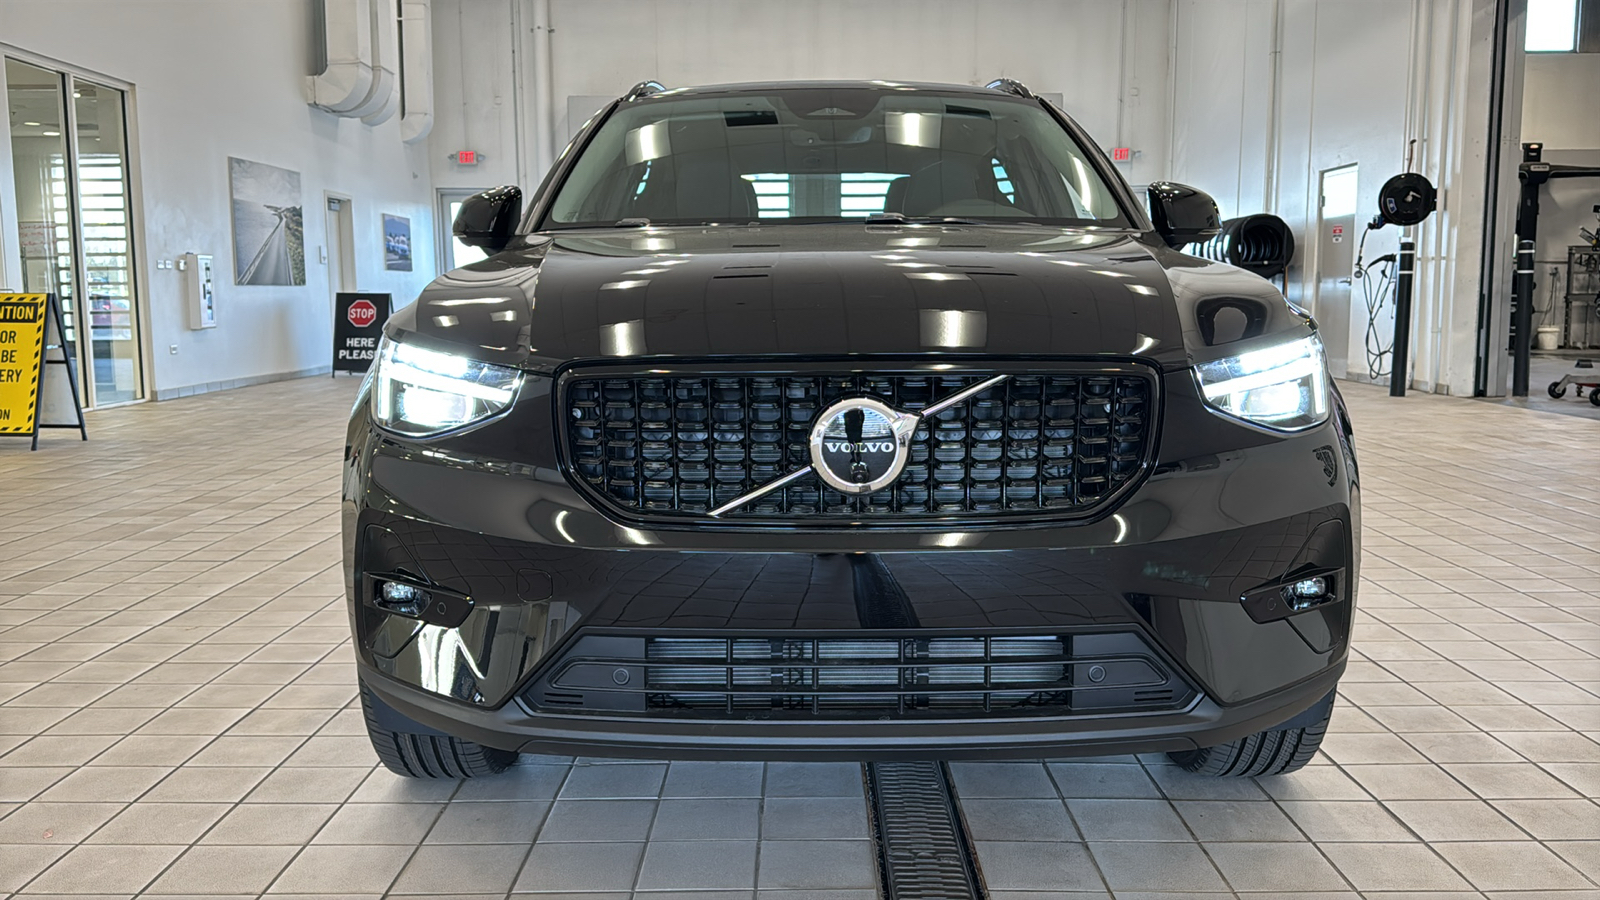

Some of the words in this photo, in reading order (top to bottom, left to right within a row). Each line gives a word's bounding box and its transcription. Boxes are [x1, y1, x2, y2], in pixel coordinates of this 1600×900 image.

[1114, 148, 1129, 160] EXIT
[350, 308, 374, 319] STOP
[346, 338, 375, 348] HERE
[1, 349, 17, 363] BE
[338, 350, 376, 360] PLEAS
[0, 369, 22, 382] ERY
[824, 442, 894, 453] VOLVO
